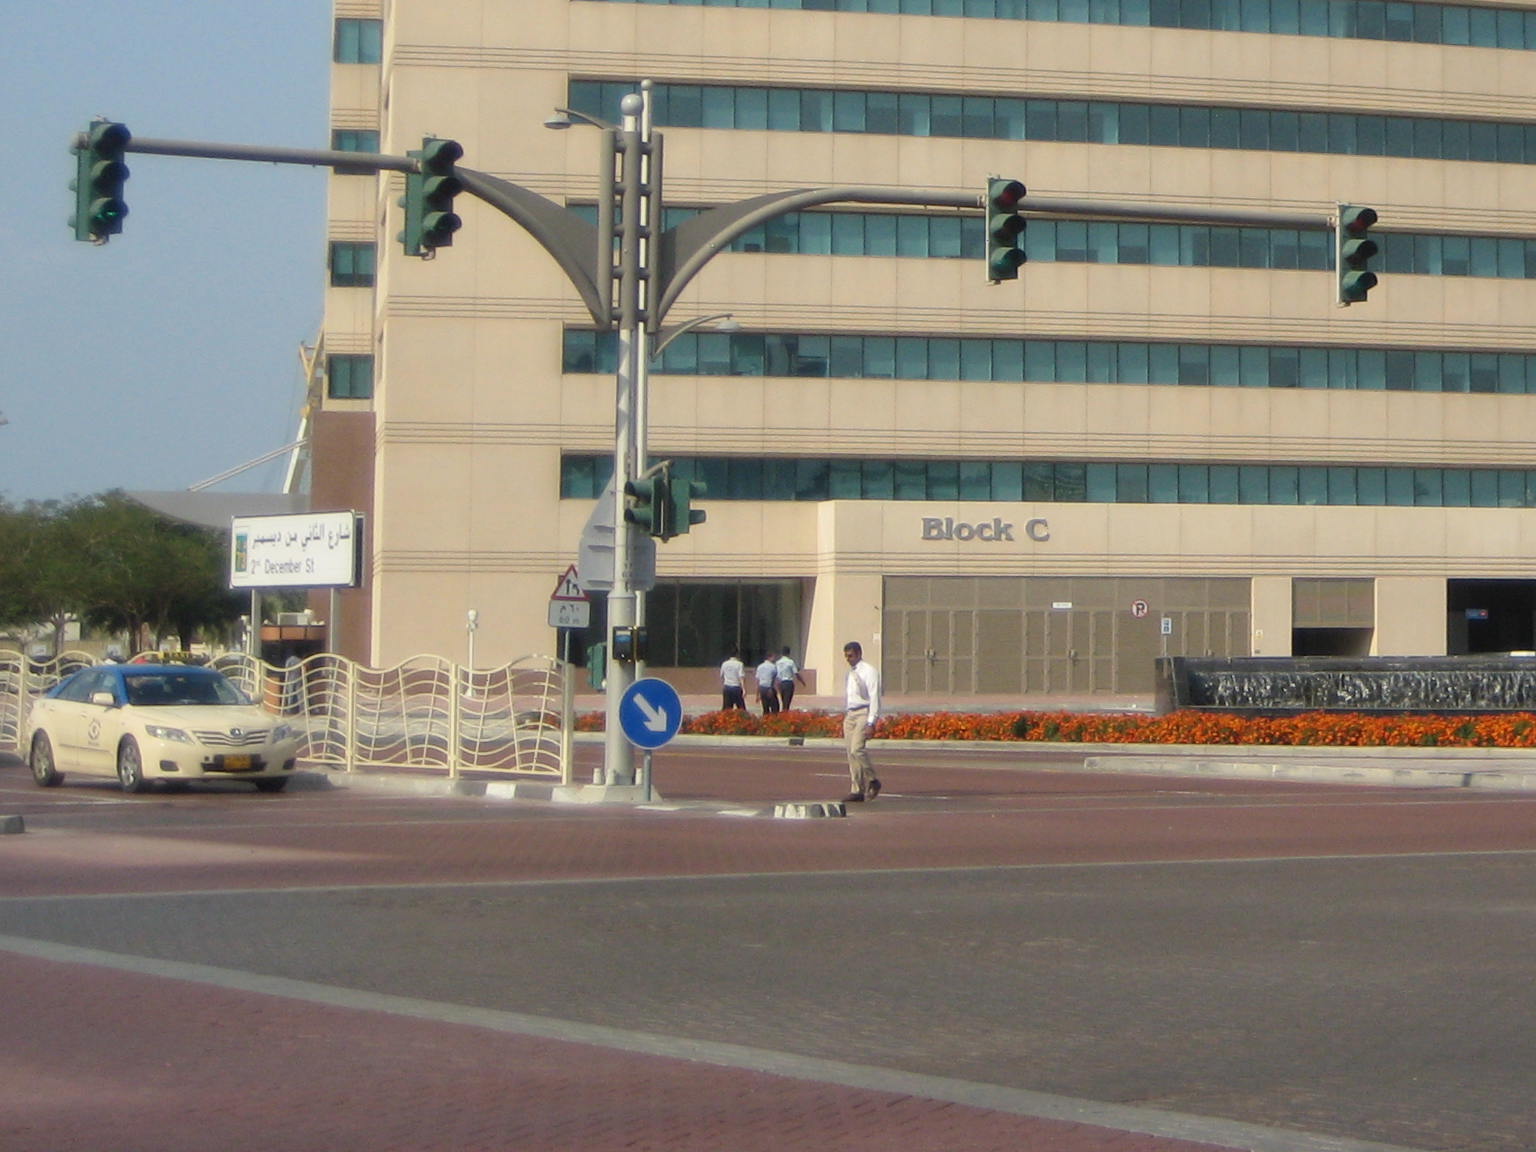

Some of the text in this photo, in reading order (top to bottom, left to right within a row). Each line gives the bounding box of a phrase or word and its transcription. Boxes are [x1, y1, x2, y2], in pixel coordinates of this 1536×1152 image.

[922, 517, 1050, 542] Block C
[264, 558, 302, 574] December
